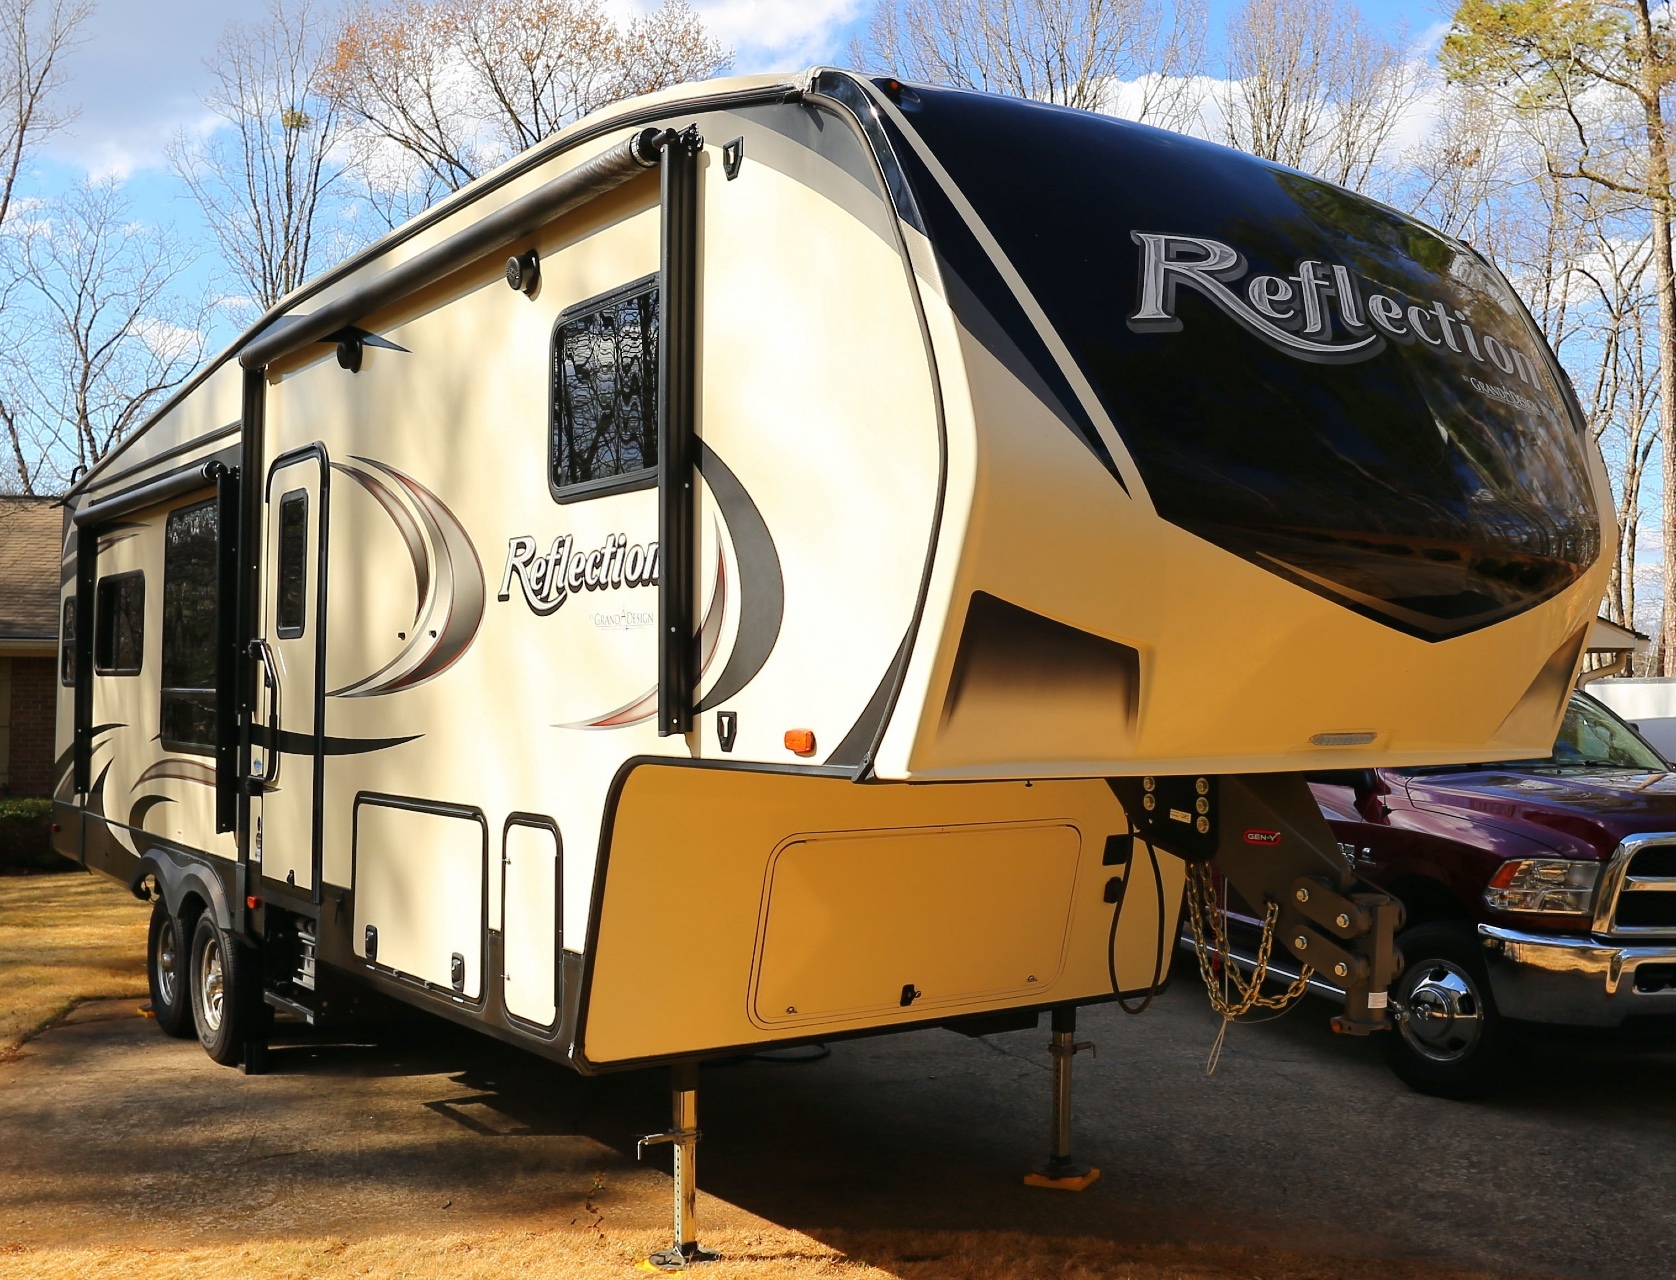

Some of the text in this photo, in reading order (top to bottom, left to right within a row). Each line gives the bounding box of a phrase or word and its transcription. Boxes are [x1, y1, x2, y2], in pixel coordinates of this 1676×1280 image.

[1127, 229, 1544, 391] Reflection
[594, 612, 621, 626] GRAND
[626, 611, 655, 625] DESIGN
[1247, 831, 1281, 842] GEN-Y
